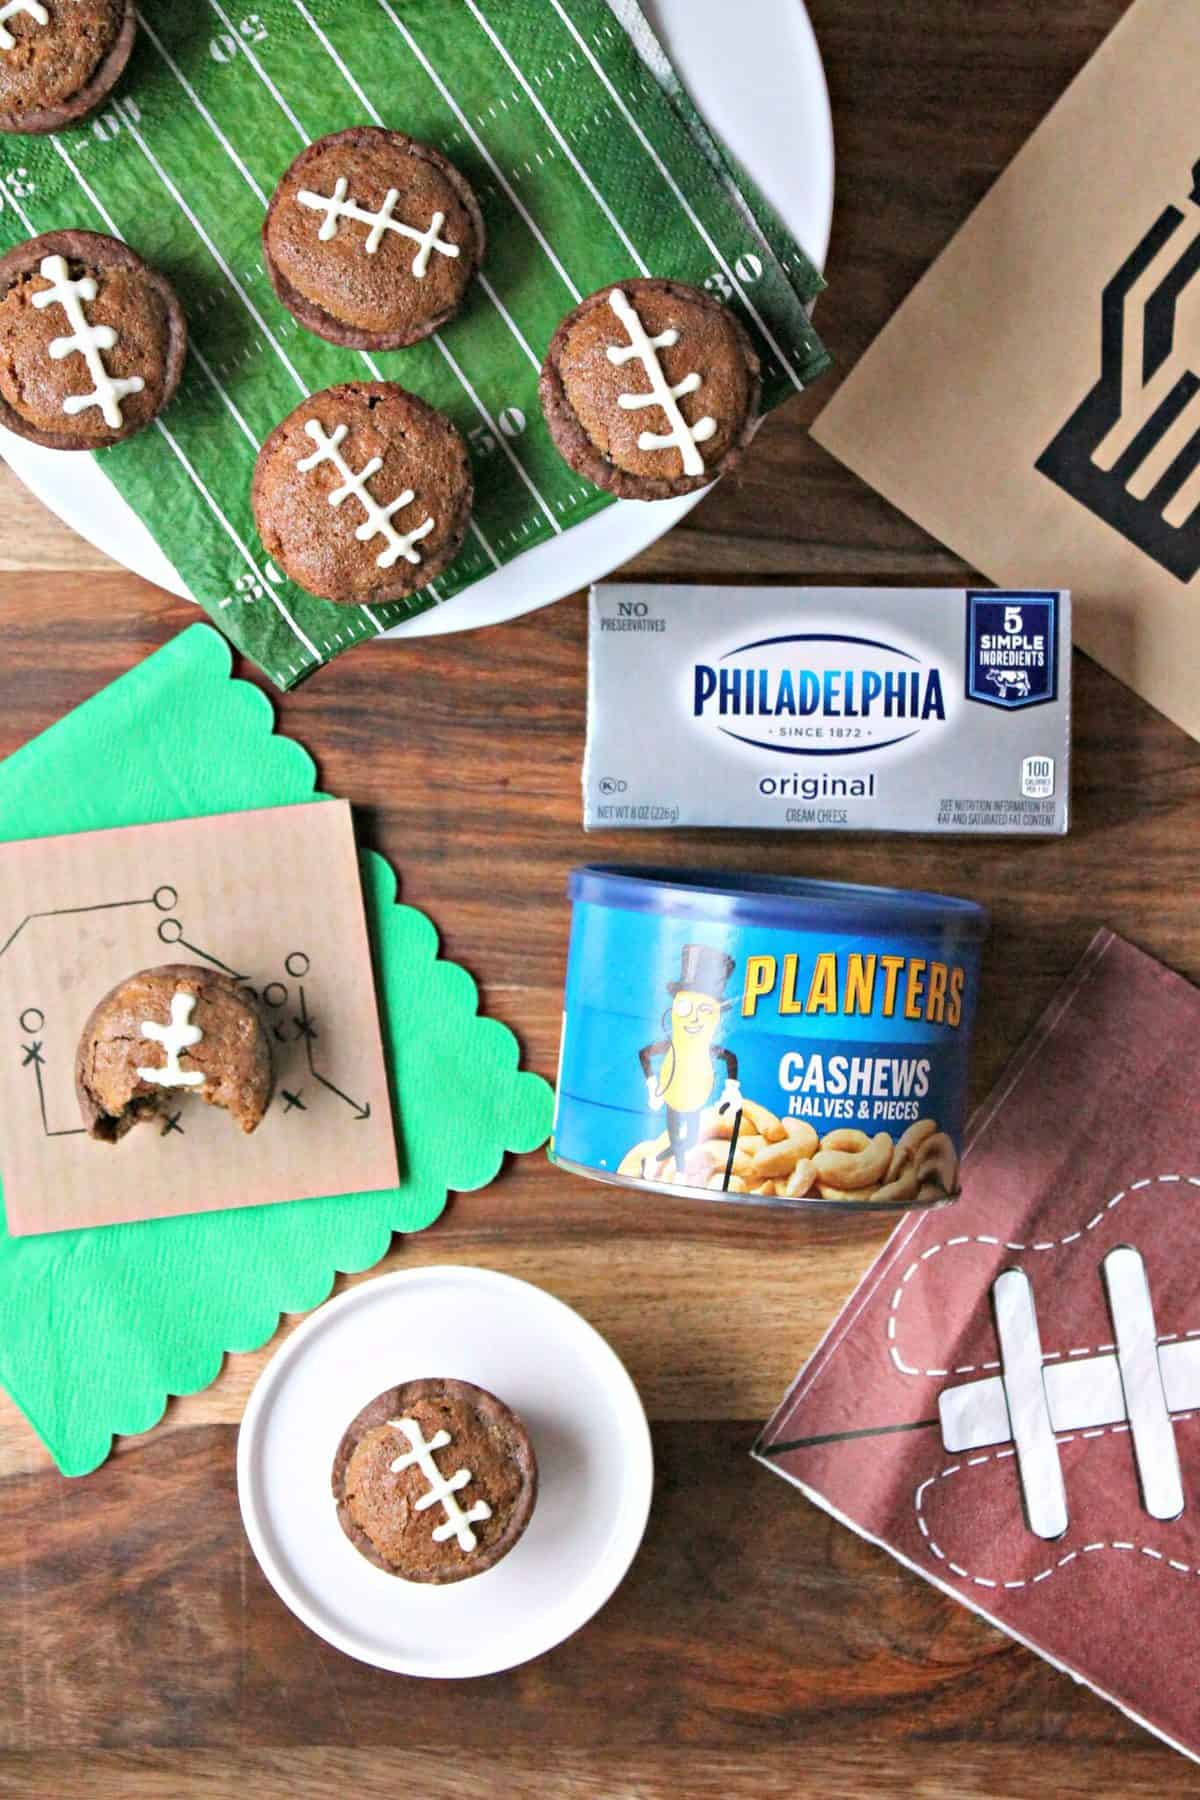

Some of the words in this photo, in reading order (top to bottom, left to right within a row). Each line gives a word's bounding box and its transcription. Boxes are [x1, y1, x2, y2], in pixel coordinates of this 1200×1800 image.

[617, 602, 648, 616] NO
[600, 617, 666, 632] PRESERVATIVES
[1003, 606, 1023, 634] 5
[981, 634, 1045, 650] SIMPLE
[979, 650, 1044, 667] INGREDIENTS
[693, 664, 946, 721] PHILADELPHIA
[779, 727, 824, 738] SINCE
[829, 727, 862, 739] 1872
[1026, 760, 1050, 777] 100
[759, 773, 875, 800] original
[598, 804, 613, 820] NET
[615, 804, 629, 819] WT
[638, 804, 649, 820] OZ
[785, 807, 816, 823] CREAM
[817, 808, 849, 824] CHEESE
[741, 951, 965, 1028] PLANTERS
[778, 1051, 932, 1098] CASHEWS
[788, 1095, 854, 1119] HALVES
[857, 1102, 871, 1120] &
[873, 1100, 920, 1121] PIECES
